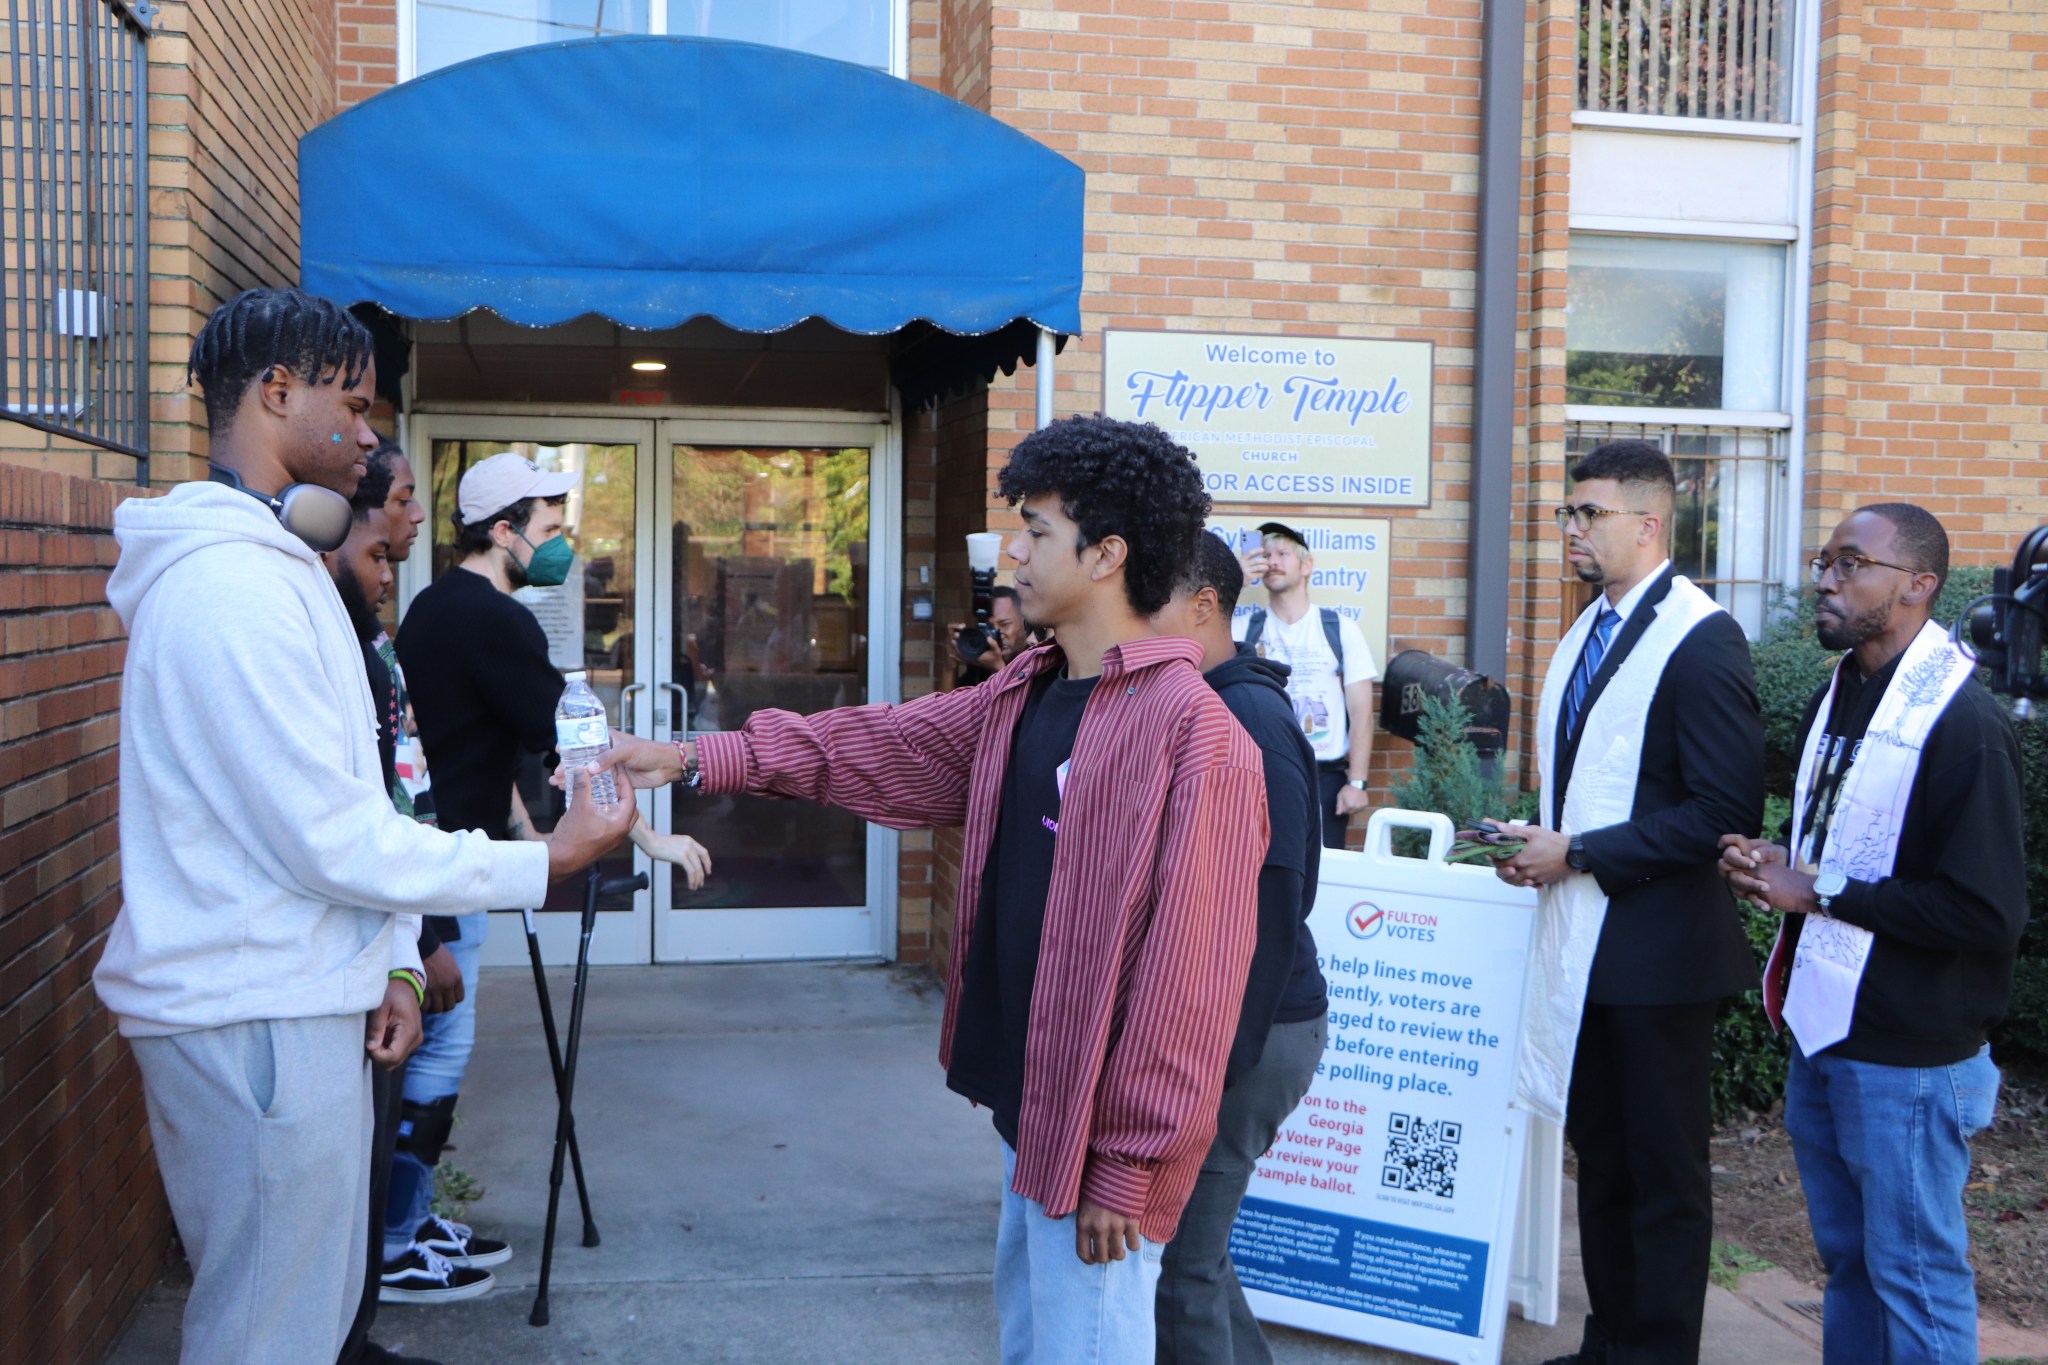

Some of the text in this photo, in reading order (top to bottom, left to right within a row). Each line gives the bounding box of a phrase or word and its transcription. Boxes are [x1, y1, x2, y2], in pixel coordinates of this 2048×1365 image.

[1206, 344, 1336, 366] Welcome to
[1126, 369, 1411, 426] Flipper Temple
[1224, 432, 1303, 446] METHODIST
[1306, 434, 1376, 447] EPISCOPAL
[1241, 450, 1298, 462] CHURCH
[1201, 472, 1413, 495] OR ACCESS INSIDE
[1294, 529, 1376, 551] illiams
[1311, 568, 1368, 592] antry
[1233, 603, 1263, 617] ach
[1387, 910, 1438, 927] FULTON
[1386, 924, 1436, 942] VOTES
[1317, 954, 1473, 990] o help lines move
[1328, 981, 1481, 1018] iently, voters are
[1328, 1010, 1499, 1049] aged to review the
[1335, 1034, 1394, 1059] before
[1399, 1048, 1479, 1077] entering
[1329, 1061, 1394, 1091] polling
[1398, 1072, 1453, 1097] place.
[1304, 1095, 1367, 1115] on to the
[1308, 1113, 1364, 1136] Georgia
[1274, 1129, 1362, 1156] y Voter Page
[1262, 1148, 1359, 1175] o review your
[1257, 1167, 1356, 1196] sample ballot.
[1353, 1240, 1366, 1250] the
[1361, 1233, 1374, 1242] you
[1351, 1261, 1366, 1271] also
[1415, 1274, 1428, 1283] the
[1352, 1250, 1375, 1263] listing
[1404, 1261, 1419, 1271] and
[1456, 1272, 1469, 1281] are
[1382, 1277, 1393, 1286] for
